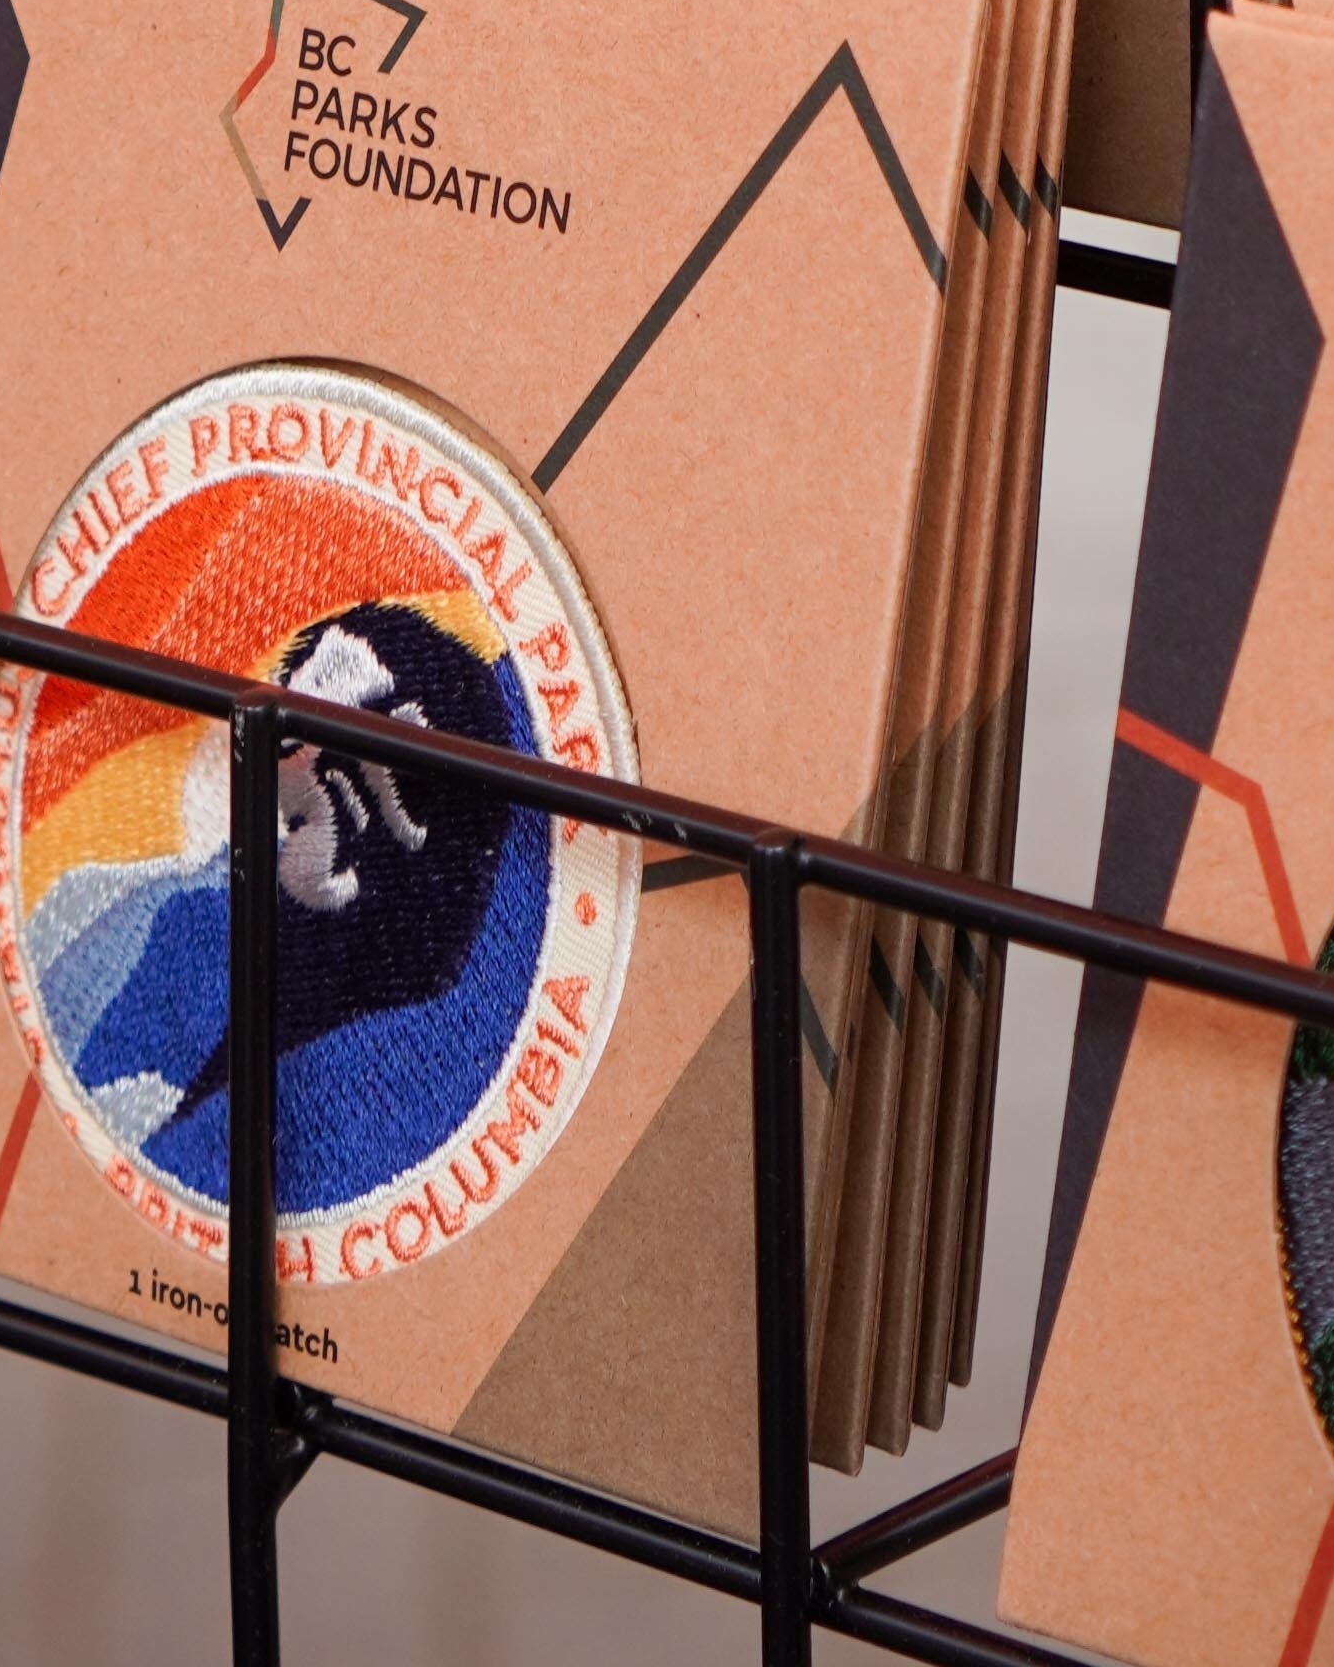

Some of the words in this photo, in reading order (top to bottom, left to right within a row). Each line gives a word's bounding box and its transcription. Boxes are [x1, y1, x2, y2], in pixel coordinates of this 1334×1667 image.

[299, 27, 356, 77] BC
[291, 79, 438, 148] PARKS
[284, 130, 572, 235] FOUNDATION
[31, 436, 171, 617] CHIEF
[189, 402, 533, 624] PROVINCIAL
[340, 973, 592, 1281] COLUMBIA
[128, 1269, 142, 1296] 1
[151, 1269, 229, 1325] iron-o
[275, 1322, 339, 1364] atch
